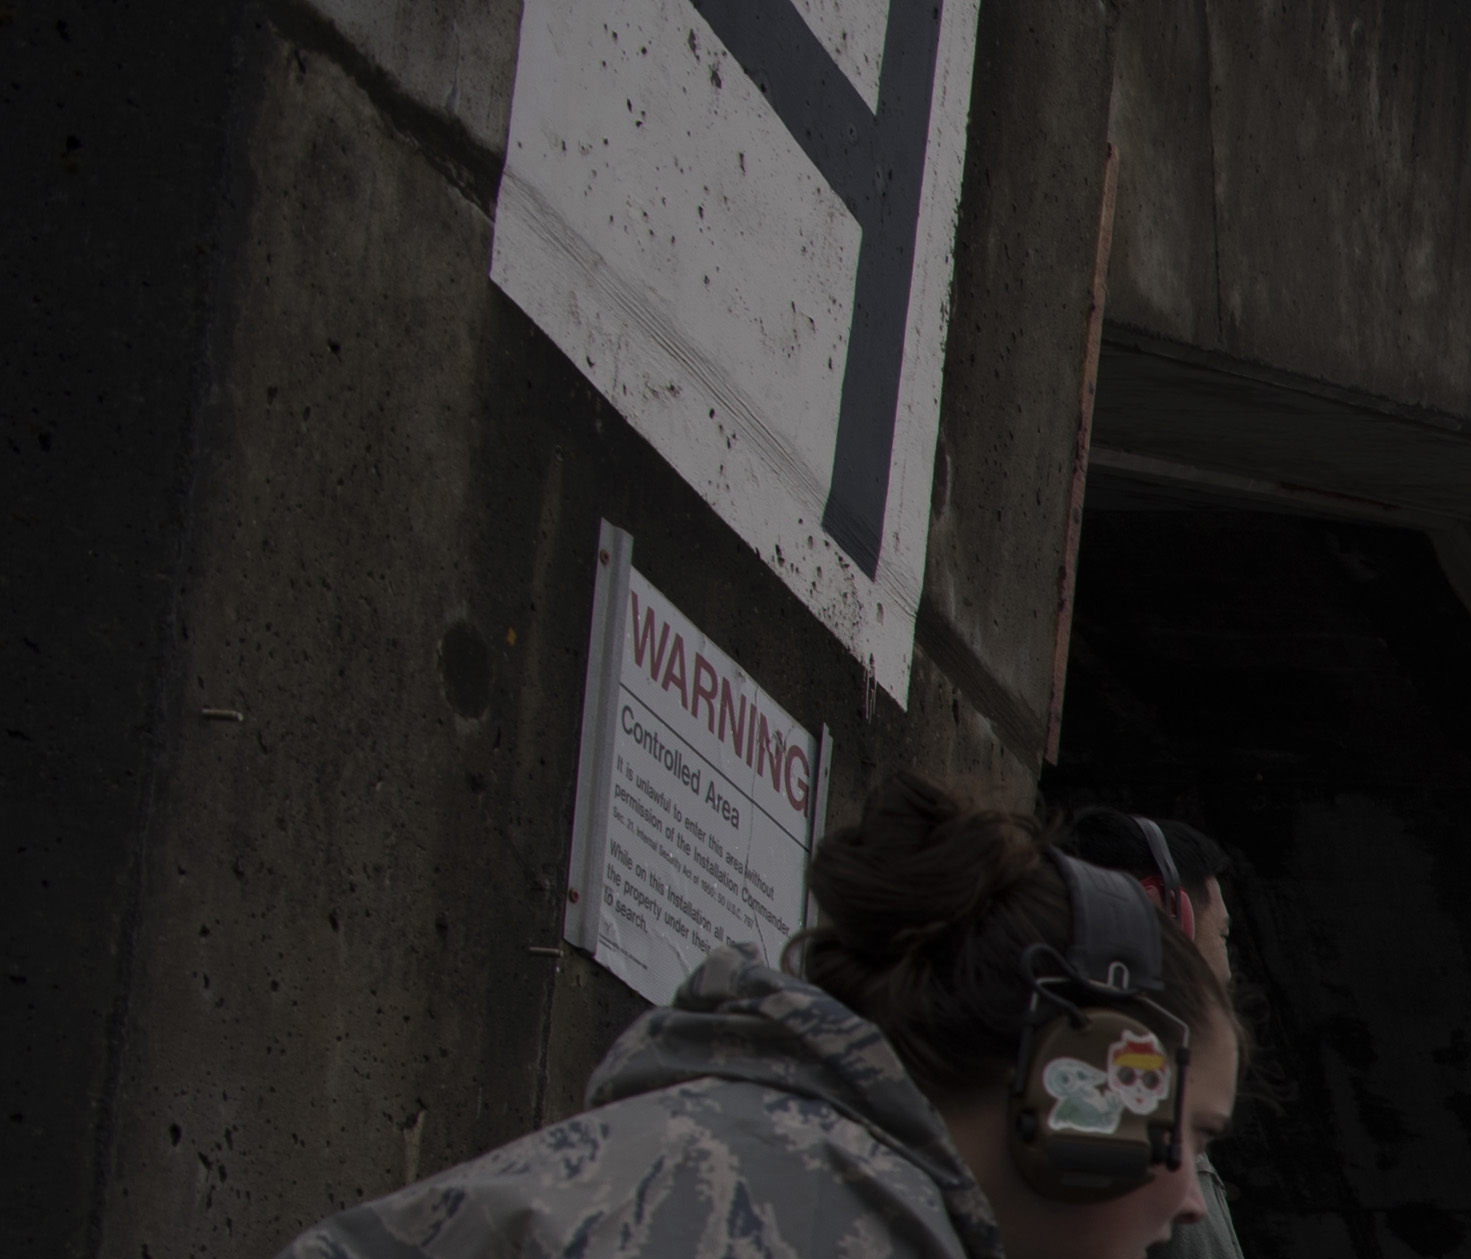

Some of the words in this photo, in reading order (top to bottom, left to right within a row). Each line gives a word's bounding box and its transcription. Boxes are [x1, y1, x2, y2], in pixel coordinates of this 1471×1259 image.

[630, 590, 811, 813] WARNING
[620, 701, 700, 797] Controlled
[705, 777, 740, 832] Area
[614, 785, 662, 831] permission
[665, 823, 674, 842] of
[676, 833, 691, 856] the
[693, 847, 738, 895] Installation
[616, 754, 623, 773] It
[625, 762, 633, 781] is
[636, 775, 670, 814] unlawful
[673, 804, 682, 824] to
[684, 814, 705, 843] enter
[708, 833, 723, 858] this
[725, 850, 742, 874] area
[744, 863, 774, 900] without
[682, 863, 692, 880] Act
[606, 863, 621, 887] the
[623, 879, 660, 921] property
[664, 913, 689, 940] under
[609, 839, 633, 870] While
[635, 863, 646, 881] on
[649, 871, 664, 896] this
[667, 885, 711, 933] Installation
[714, 922, 723, 942] all
[615, 900, 648, 935] search.
